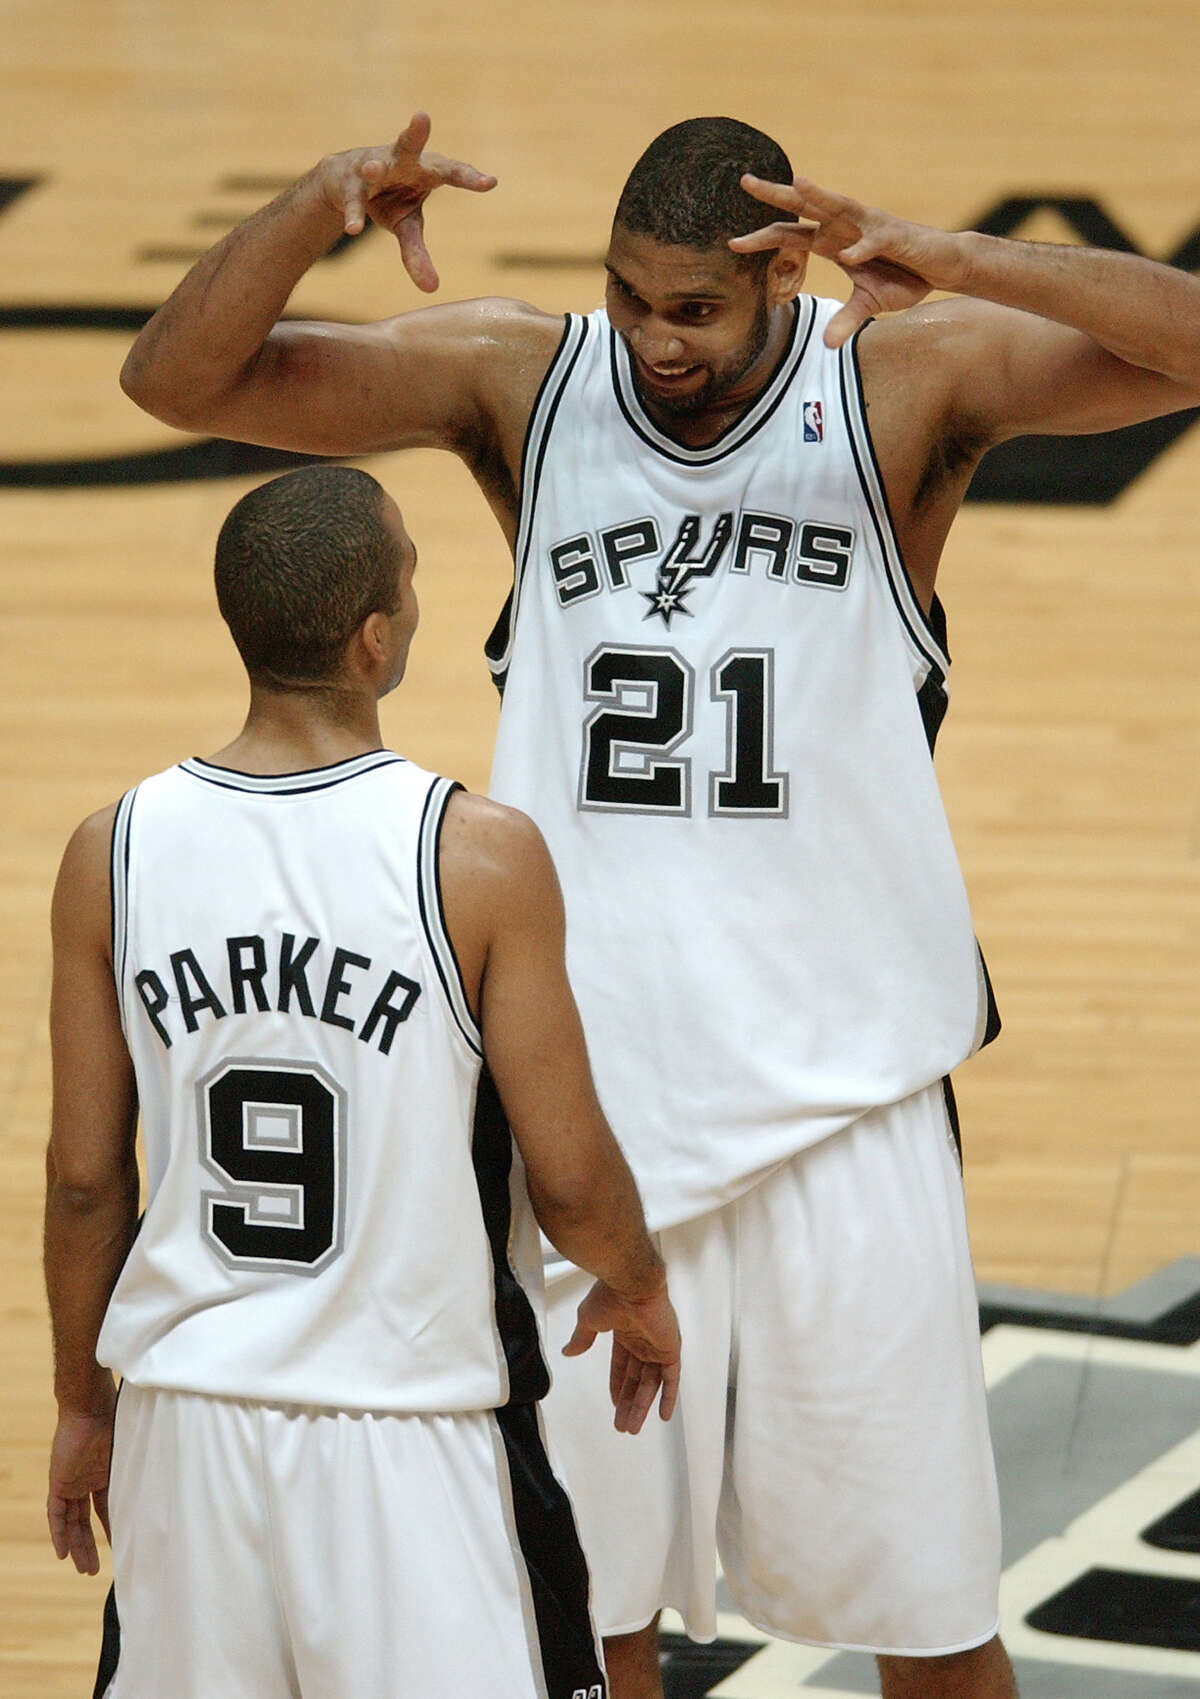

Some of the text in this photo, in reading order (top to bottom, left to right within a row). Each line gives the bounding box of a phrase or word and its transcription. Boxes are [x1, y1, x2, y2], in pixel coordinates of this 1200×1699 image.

[549, 508, 856, 630] SPURS
[577, 641, 789, 819] 21
[134, 932, 422, 1056] PARKER
[194, 1056, 349, 1278] 9
